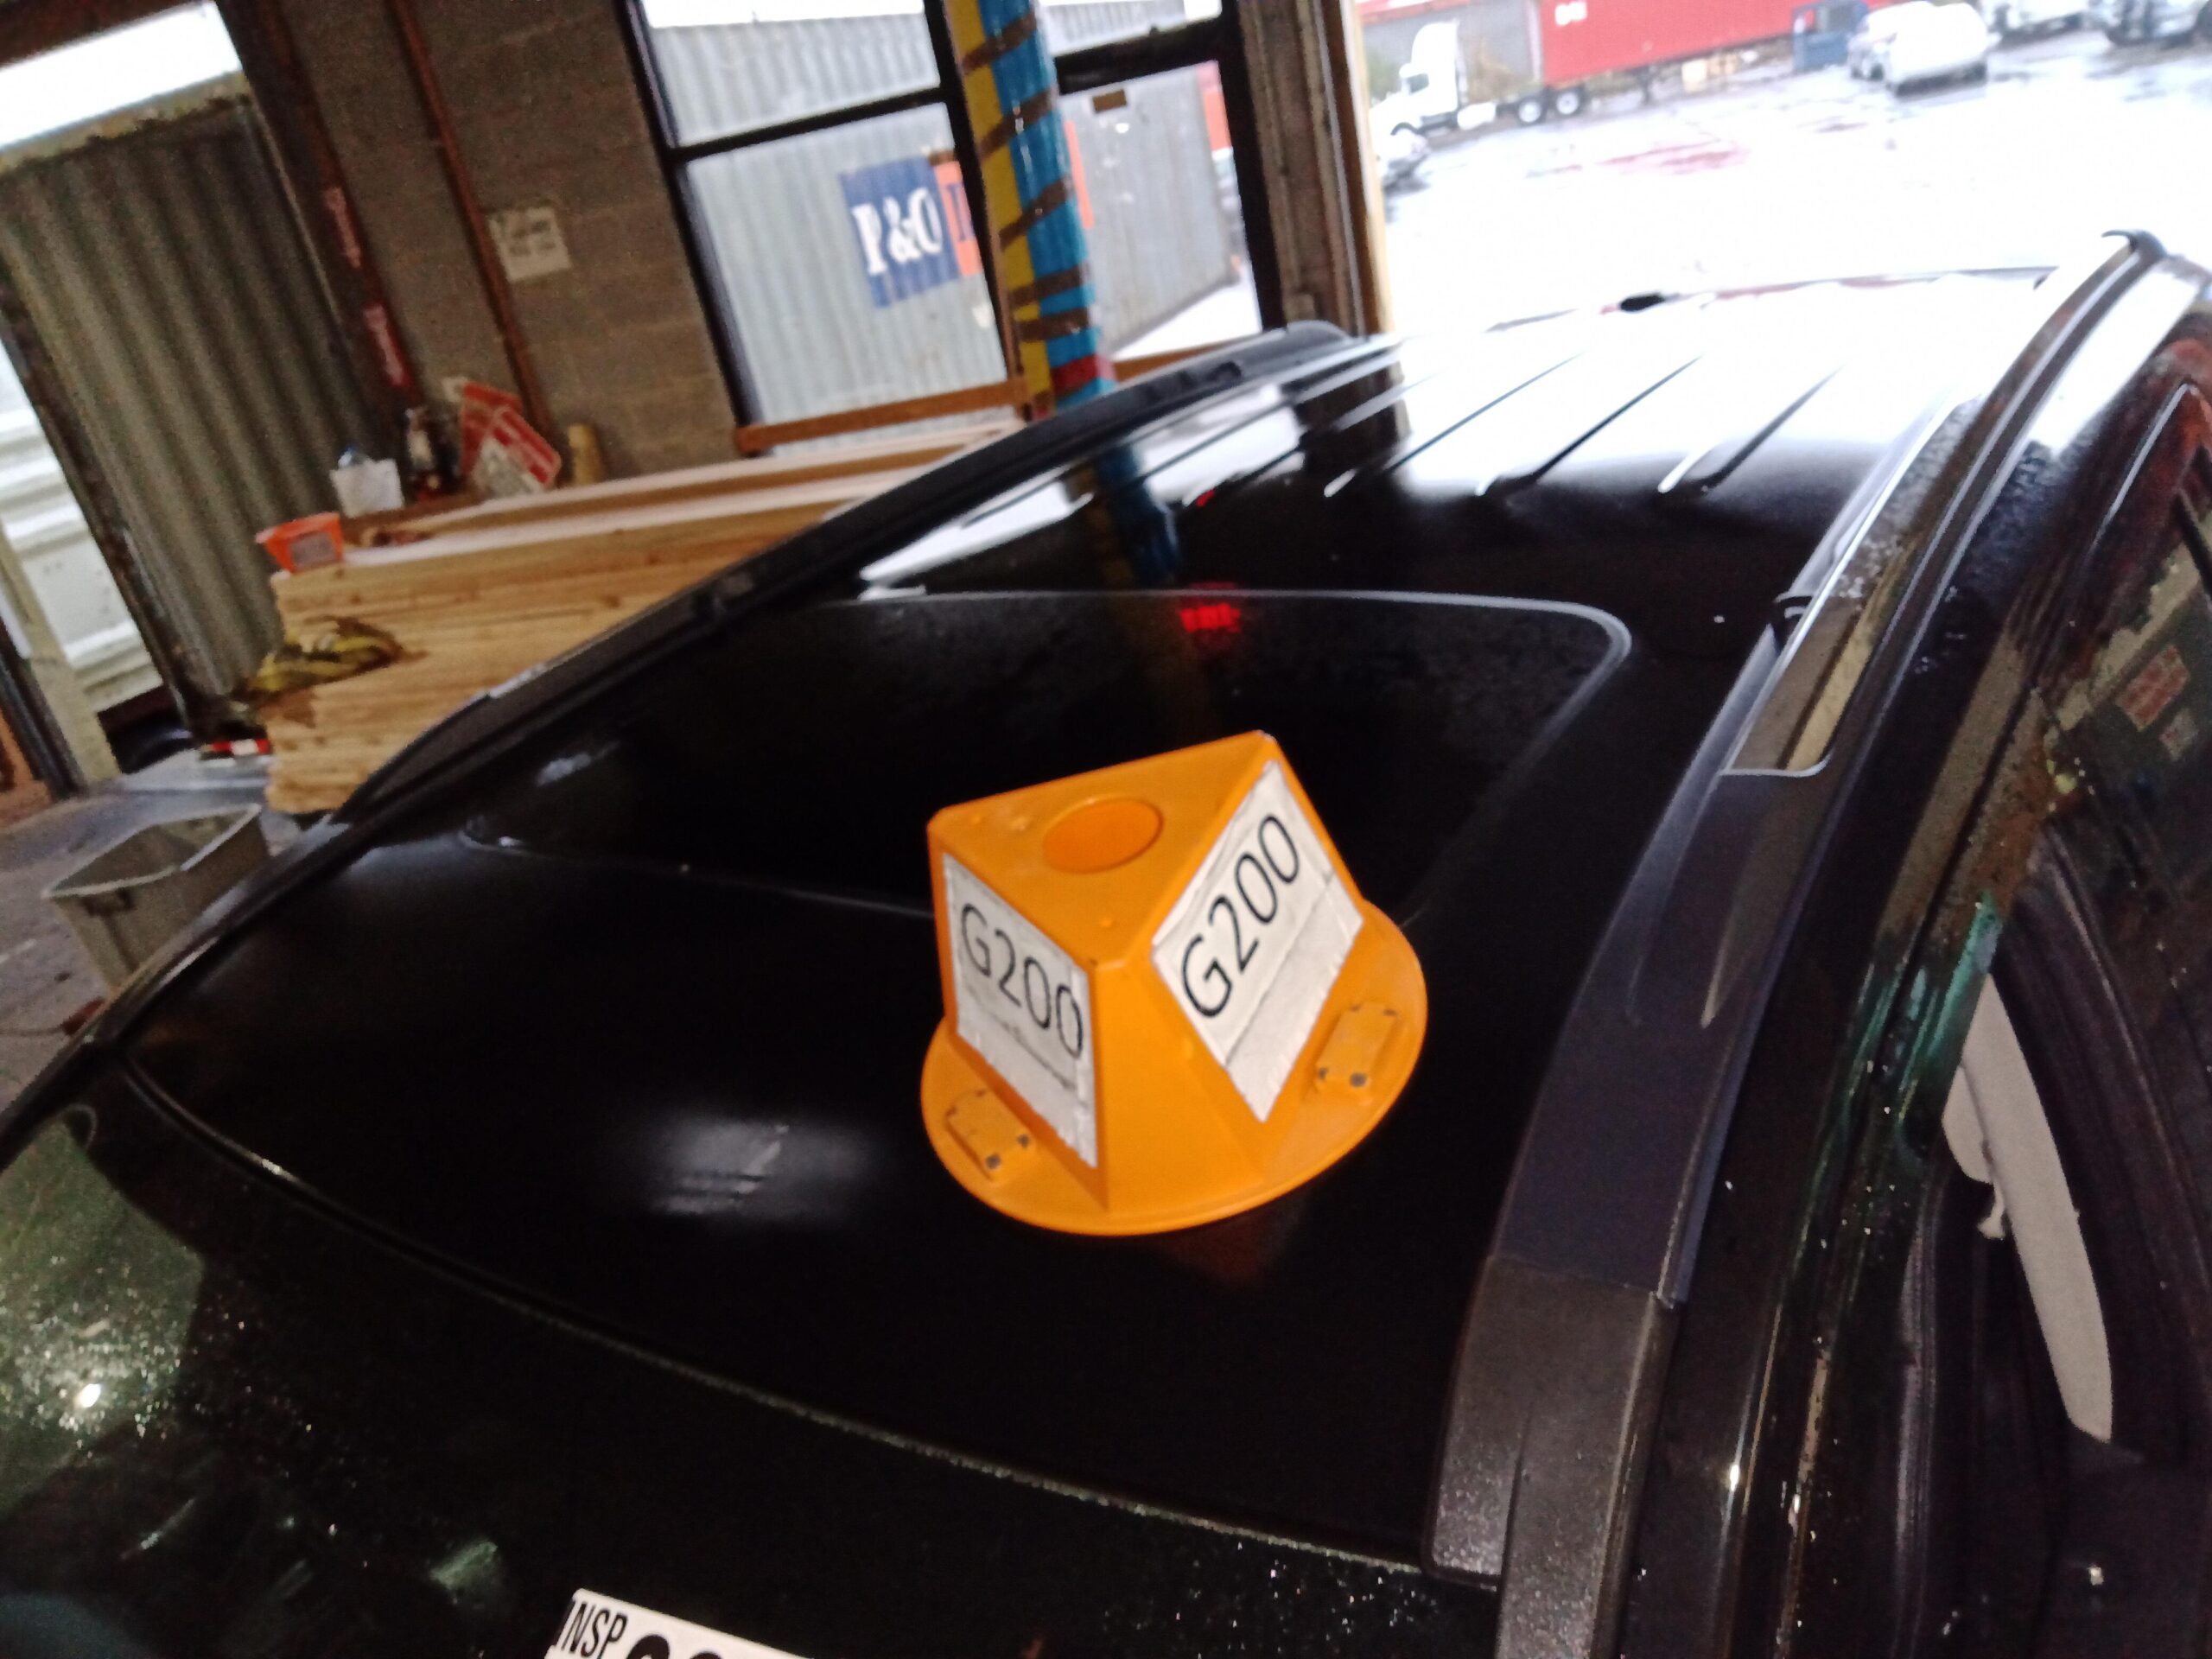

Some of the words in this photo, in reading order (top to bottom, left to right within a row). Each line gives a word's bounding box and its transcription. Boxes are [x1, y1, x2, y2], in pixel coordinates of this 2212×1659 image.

[851, 187, 943, 275] P&O
[961, 903, 1084, 1058] G200
[1180, 813, 1300, 1018] G200
